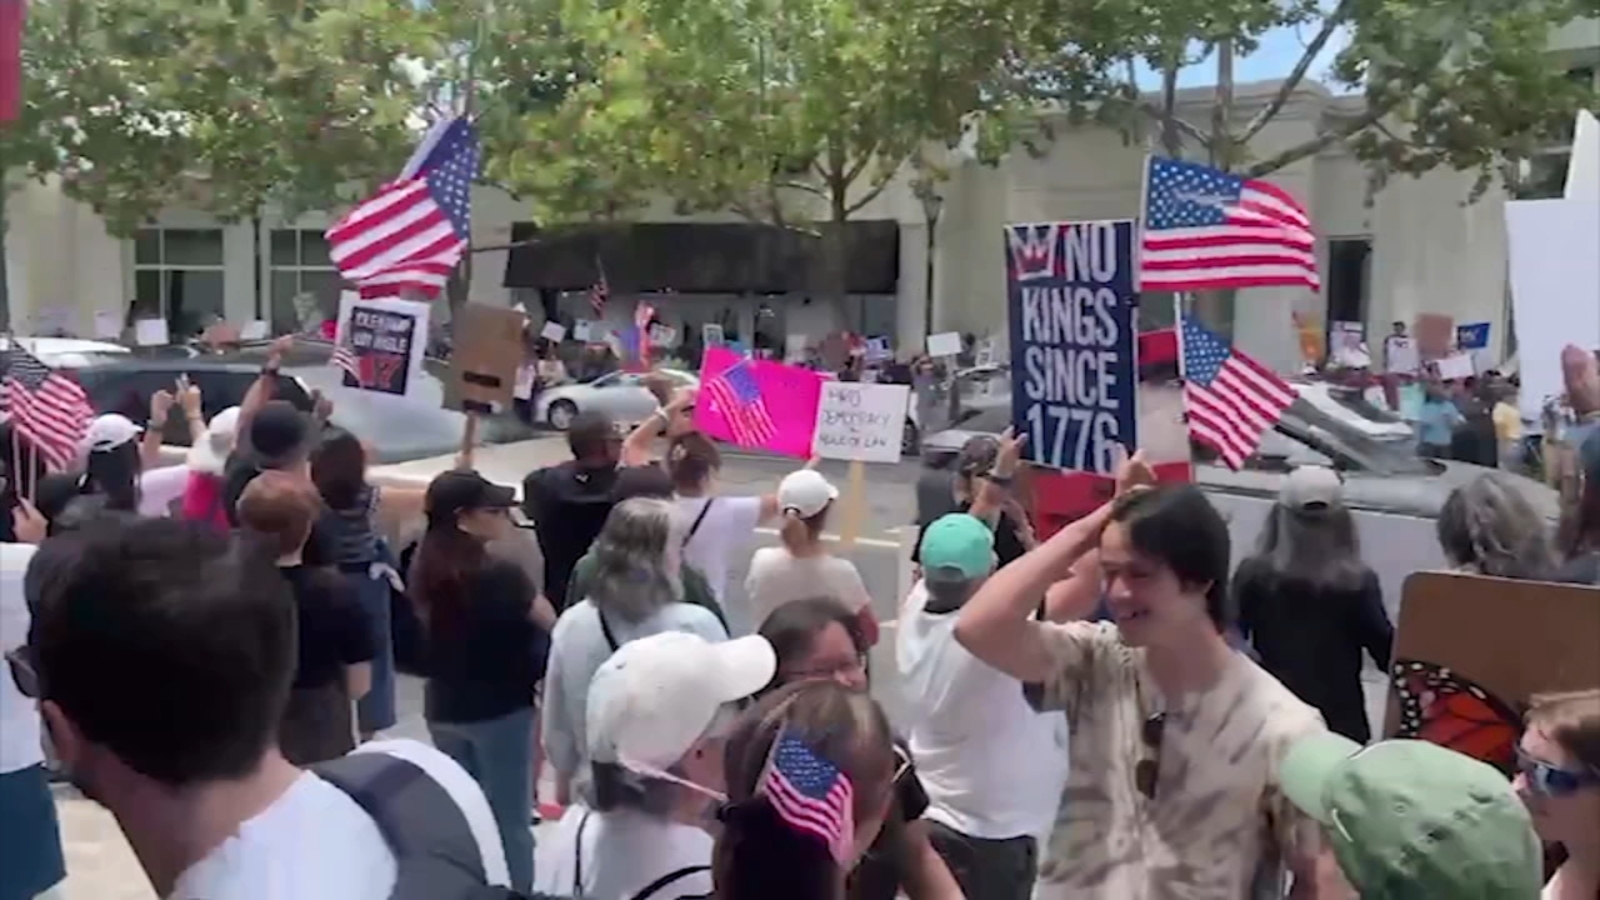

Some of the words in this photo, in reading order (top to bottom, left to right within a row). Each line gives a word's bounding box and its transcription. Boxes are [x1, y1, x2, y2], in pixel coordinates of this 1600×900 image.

[1065, 224, 1117, 283] NO
[1022, 286, 1118, 348] KINGS
[1024, 346, 1118, 409] SINCE
[1027, 403, 1119, 476] 1776
